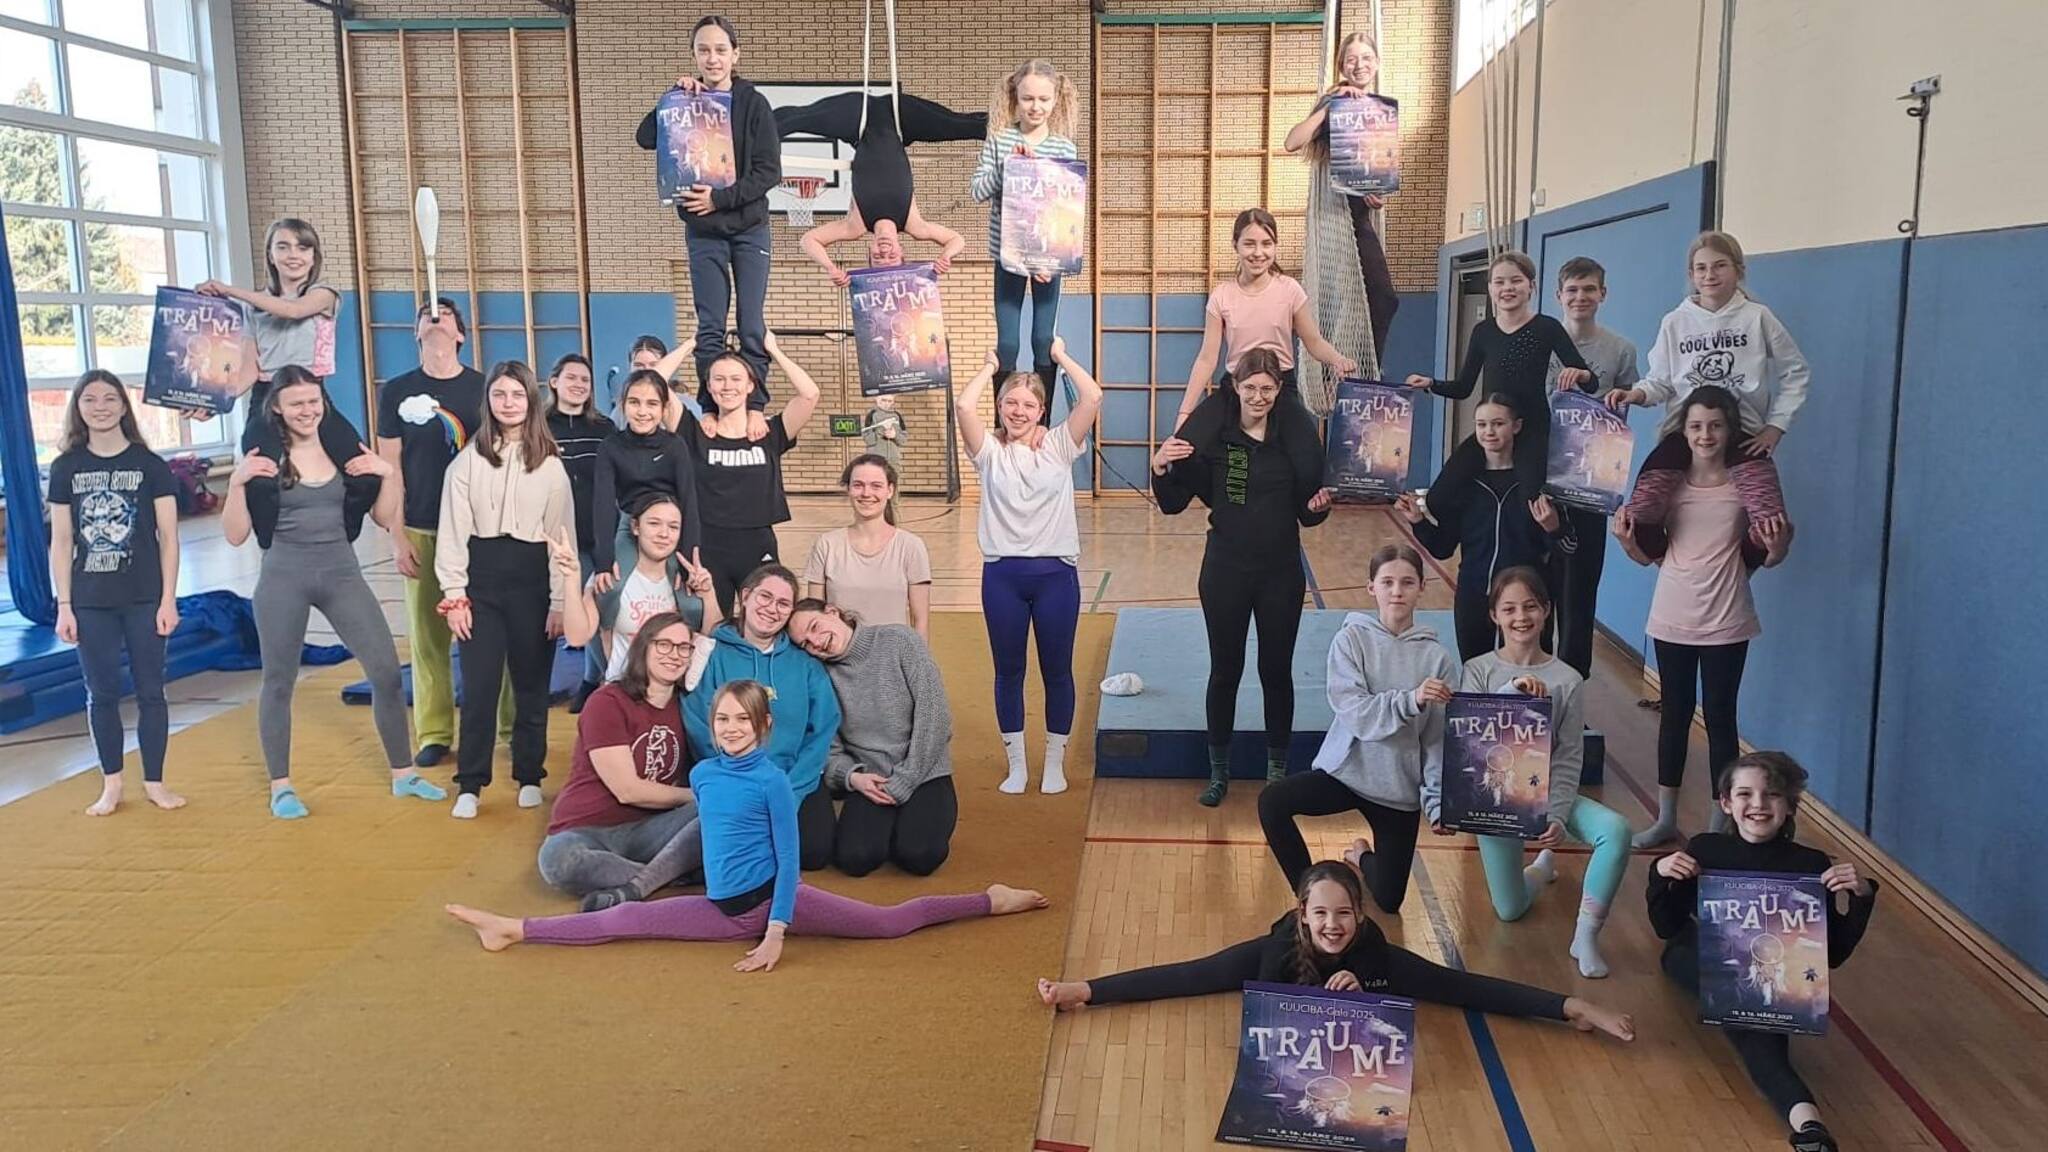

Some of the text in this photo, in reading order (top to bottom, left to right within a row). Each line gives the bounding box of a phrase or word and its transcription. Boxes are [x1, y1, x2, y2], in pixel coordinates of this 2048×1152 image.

[660, 101, 728, 130] TRÄUME
[854, 281, 937, 312] TRÄUME
[158, 305, 241, 337] TRÄUME
[1680, 334, 1747, 354] COOL VIBES
[1338, 396, 1411, 423] TRÄUME
[1556, 408, 1622, 434] TRÄUM
[708, 446, 766, 466] PUMA
[1450, 711, 1548, 745] TRÄUME
[1703, 893, 1821, 934] TRÄUME
[1350, 1008, 1375, 1020] 2025
[1249, 1021, 1408, 1079] TRÄUME
